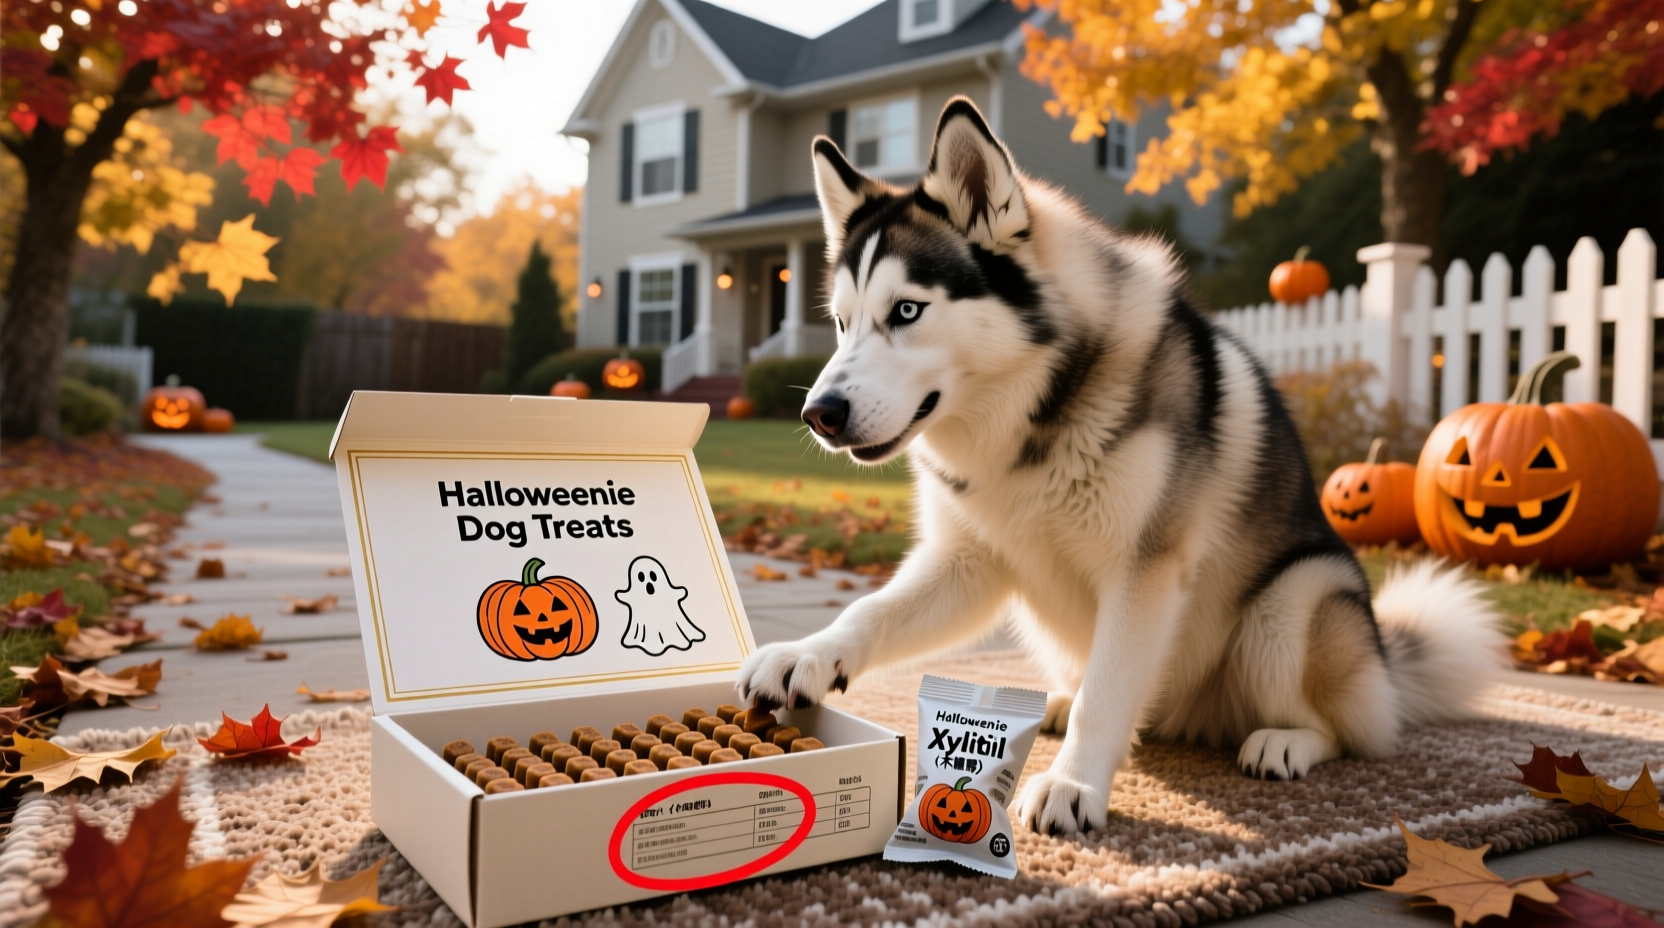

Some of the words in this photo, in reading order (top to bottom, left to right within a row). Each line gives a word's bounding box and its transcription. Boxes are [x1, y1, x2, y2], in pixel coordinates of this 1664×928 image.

[438, 479, 636, 507] Halloweenie
[456, 515, 528, 548] Dog
[531, 513, 634, 539] Treats
